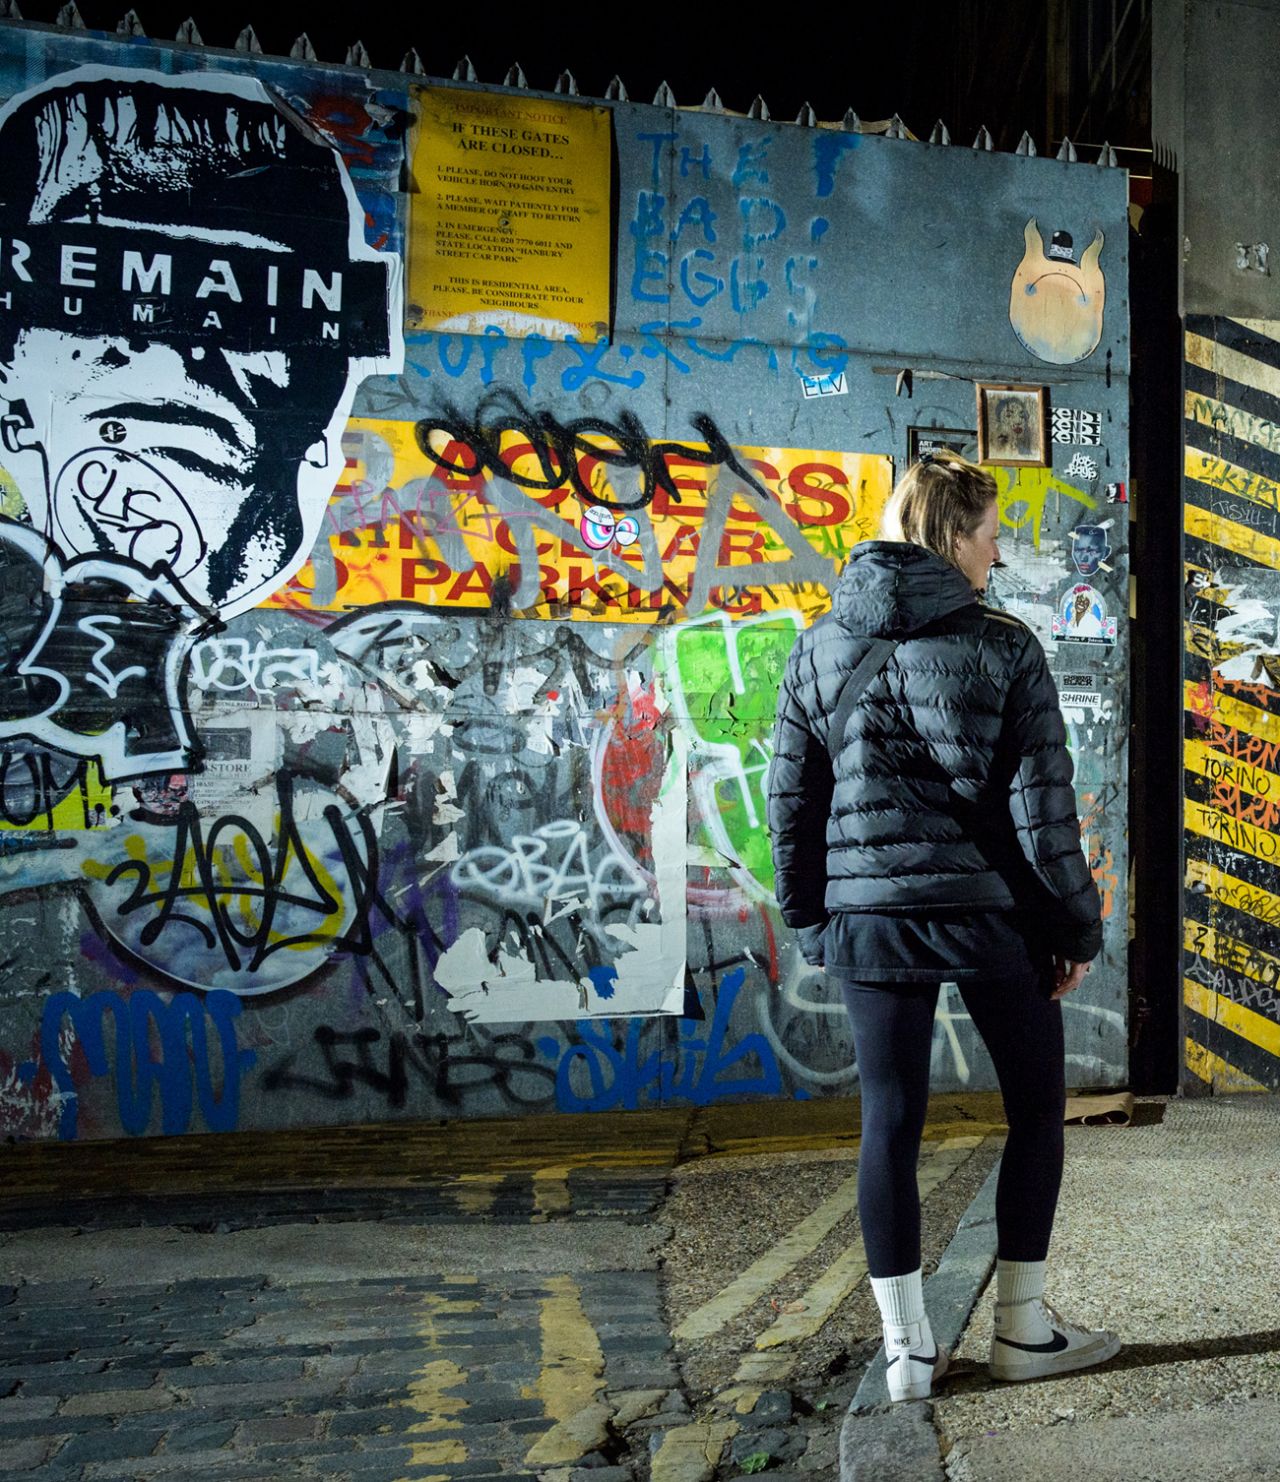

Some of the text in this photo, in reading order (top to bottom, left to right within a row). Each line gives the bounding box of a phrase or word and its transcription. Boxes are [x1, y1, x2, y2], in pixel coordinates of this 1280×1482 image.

[456, 104, 568, 124] IMPORTANT NOTICE
[453, 122, 570, 145] IF THESE GATES
[457, 138, 488, 152] ARE
[437, 174, 576, 195] VEHICLE HORN TO GAIN ENTRY
[498, 172, 519, 180] NOT
[520, 173, 545, 182] HOOT
[547, 176, 573, 186] YOUR
[445, 204, 485, 214] MEMBER
[487, 208, 499, 216] OF
[531, 212, 544, 220] TO
[545, 214, 582, 223] RETURN
[484, 199, 508, 207] WAIT
[509, 201, 559, 212] PATIENTLY
[561, 206, 580, 214] FOR
[435, 239, 467, 249] STATE
[467, 242, 515, 253] LOCATION
[554, 241, 573, 250] AND
[435, 249, 470, 258] STREET
[472, 252, 492, 261] CAR
[0, 237, 342, 312] REMAIN
[448, 276, 470, 284] THIS
[482, 279, 541, 291] RESIDENTIAL
[471, 287, 483, 295] BE
[485, 288, 549, 301] CONSIDERATE
[551, 294, 563, 302] TO
[564, 296, 584, 304] OUR
[480, 297, 540, 309] NEIGHBOURS
[495, 516, 765, 567] CLAR
[1060, 693, 1099, 703] SHRINE
[1200, 754, 1270, 796] TORINO
[1196, 808, 1277, 857] TORINO
[893, 1336, 912, 1346] NIKE
